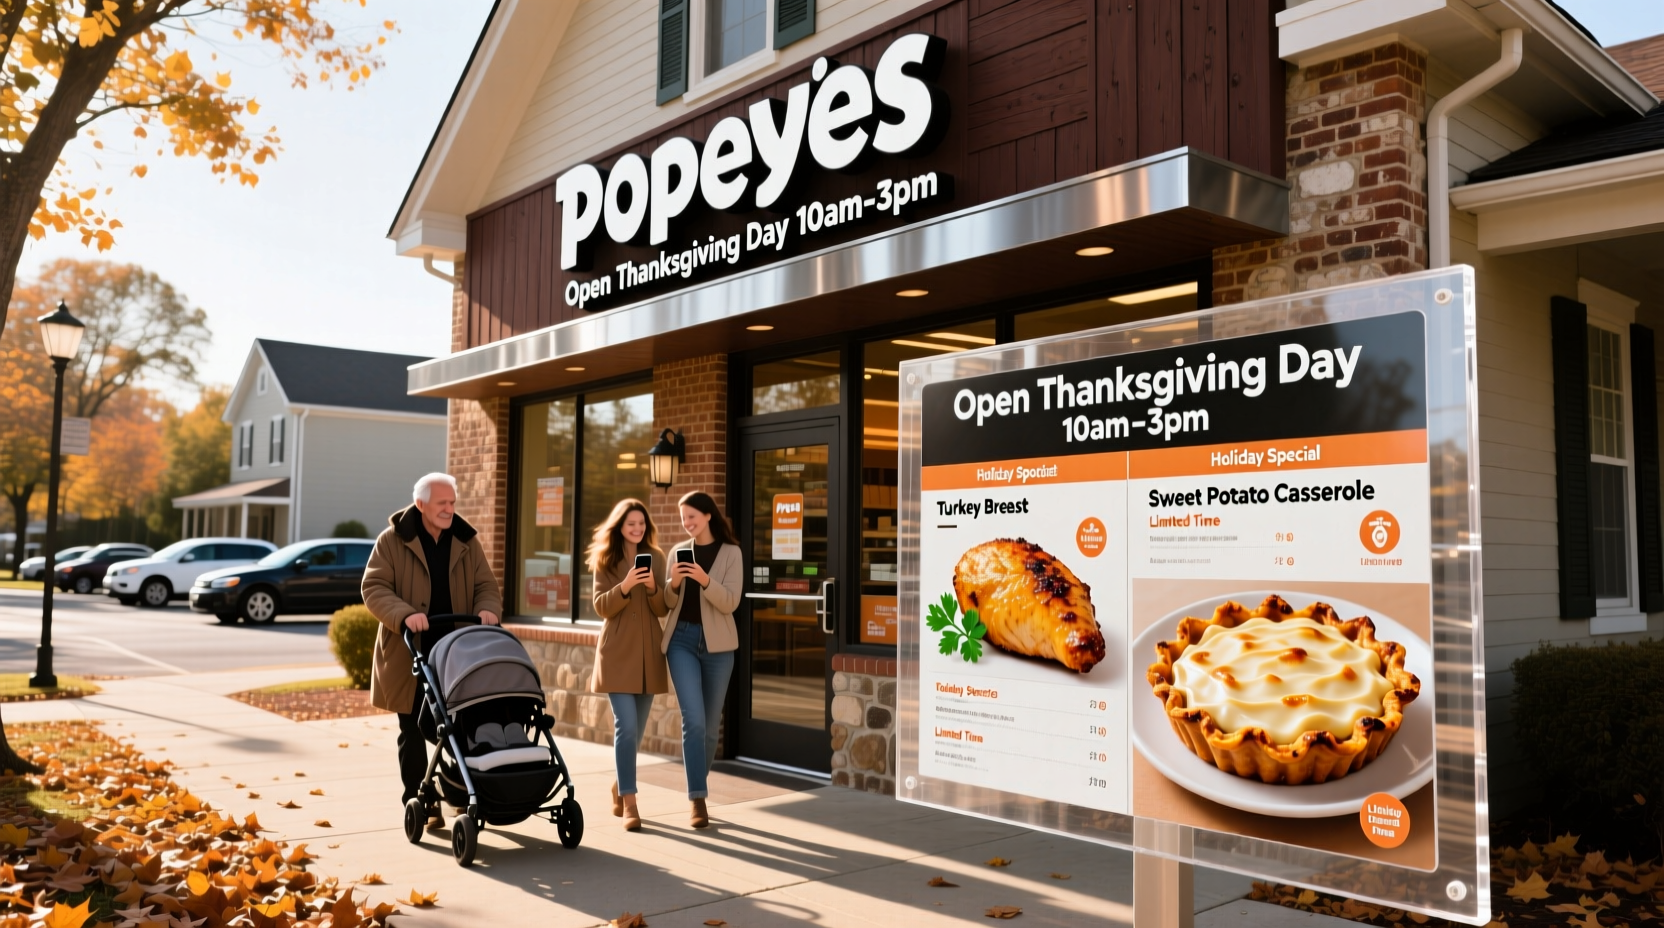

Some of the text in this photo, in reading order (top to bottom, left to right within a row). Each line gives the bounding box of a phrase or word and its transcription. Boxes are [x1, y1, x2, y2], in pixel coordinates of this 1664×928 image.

[565, 275, 611, 309] Open
[616, 234, 740, 290] Thanksgiving
[746, 217, 790, 250] Day
[953, 343, 1363, 426] Open Thanksgiving Day
[1211, 443, 1321, 468] Holiday Special
[1148, 479, 1375, 508] Sweet Potato Casserole
[937, 498, 981, 519] Turkey
